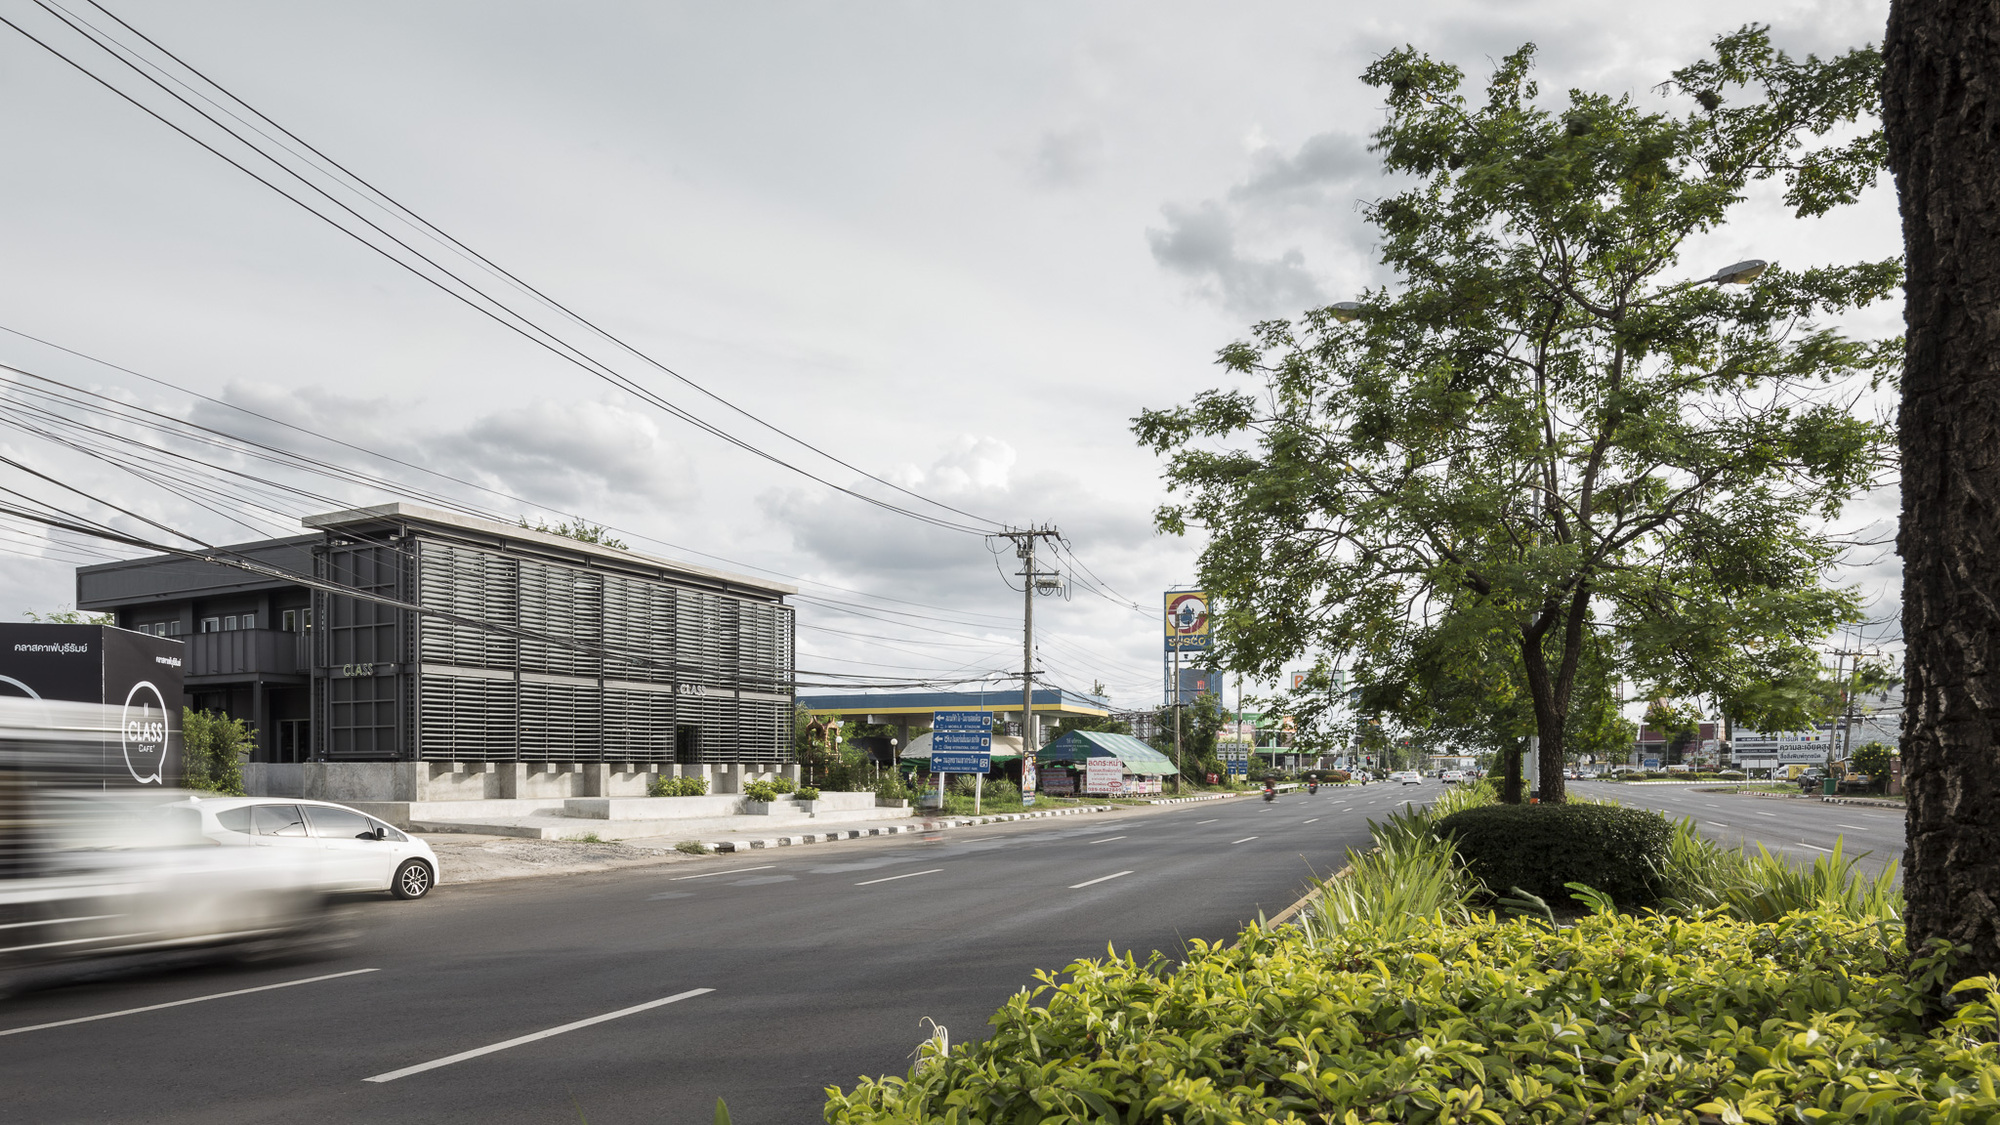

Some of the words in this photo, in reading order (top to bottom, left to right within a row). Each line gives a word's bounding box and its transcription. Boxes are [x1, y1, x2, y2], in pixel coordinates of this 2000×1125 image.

[343, 662, 374, 677] CLASS
[680, 683, 707, 696] CLASS
[128, 720, 163, 743] CLASS
